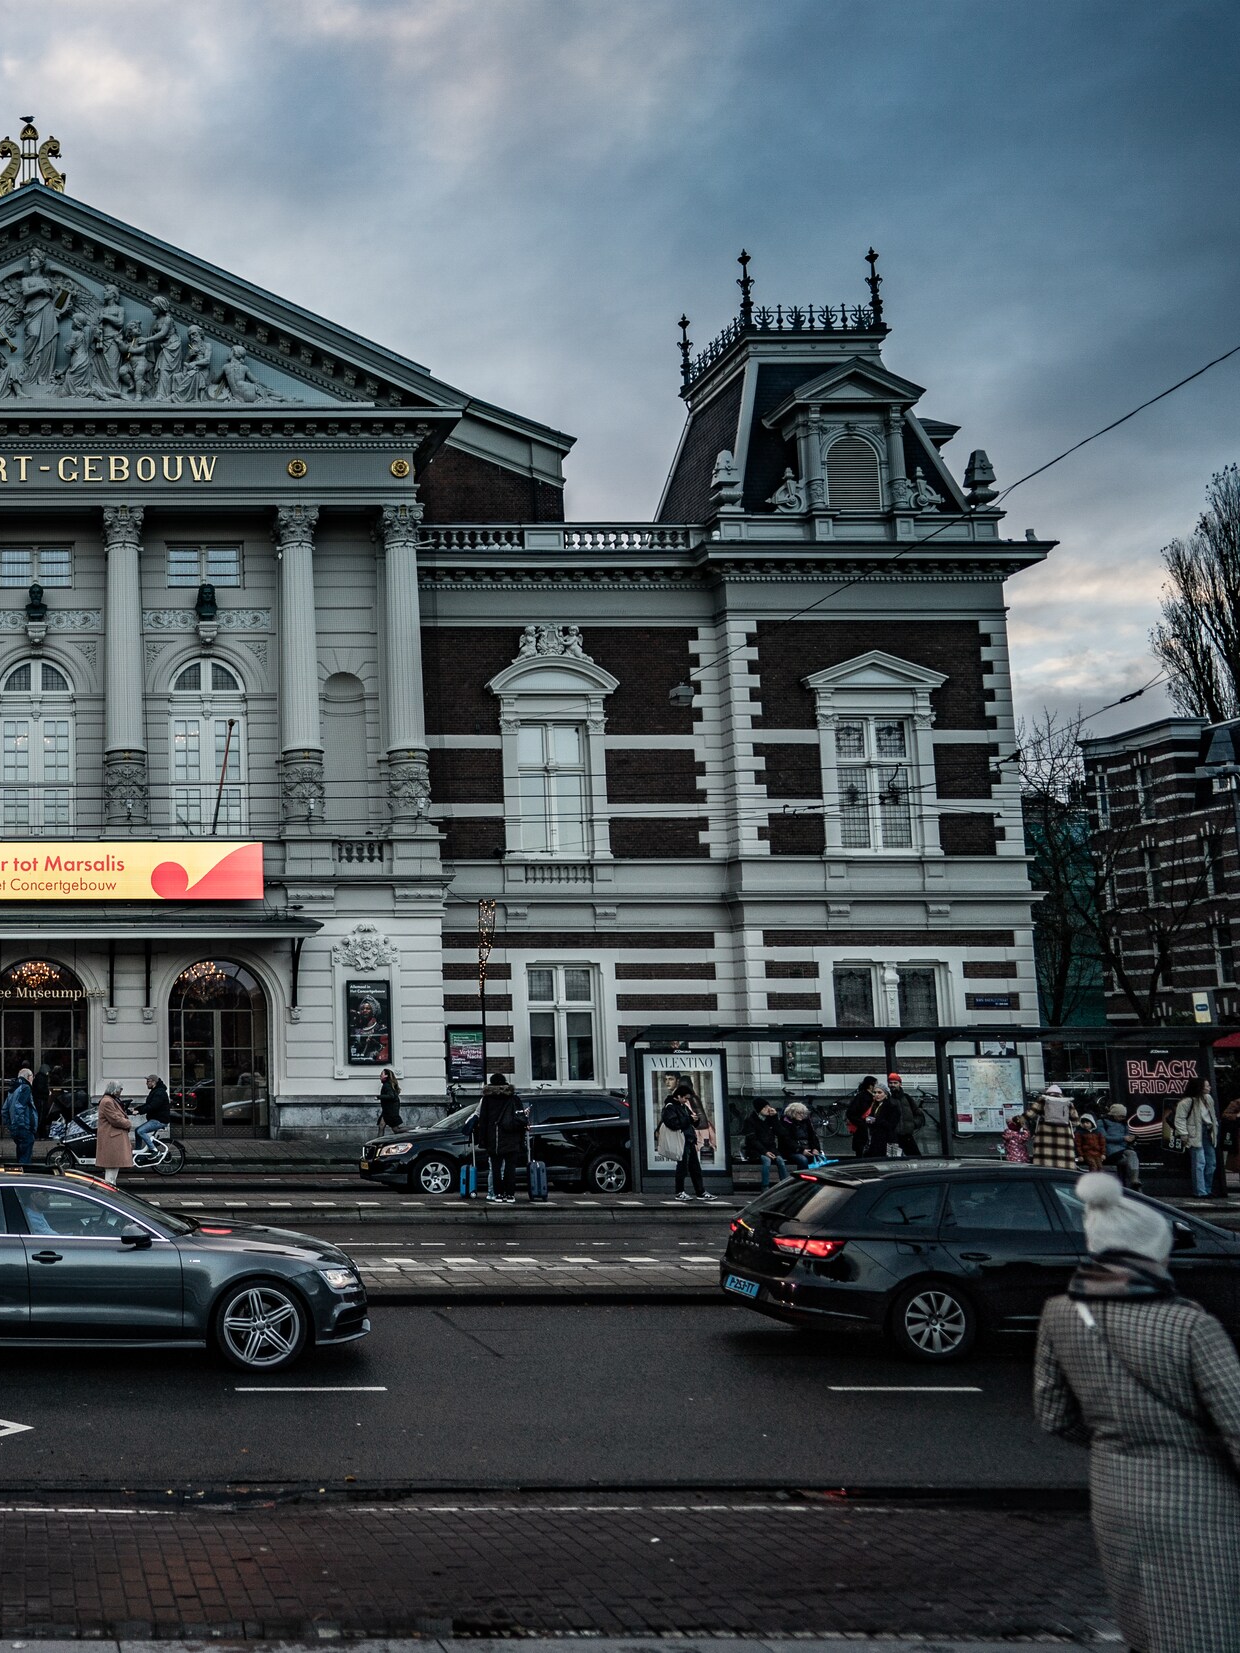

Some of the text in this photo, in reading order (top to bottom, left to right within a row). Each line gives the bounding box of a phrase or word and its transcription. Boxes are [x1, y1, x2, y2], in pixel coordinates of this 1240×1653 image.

[13, 856, 39, 872] tot
[44, 855, 125, 872] Marsalis
[10, 878, 117, 894] Concertgebouw
[651, 1057, 713, 1068] VALENTINO
[1126, 1060, 1198, 1078] BLACK
[1128, 1079, 1189, 1094] FRIDAY
